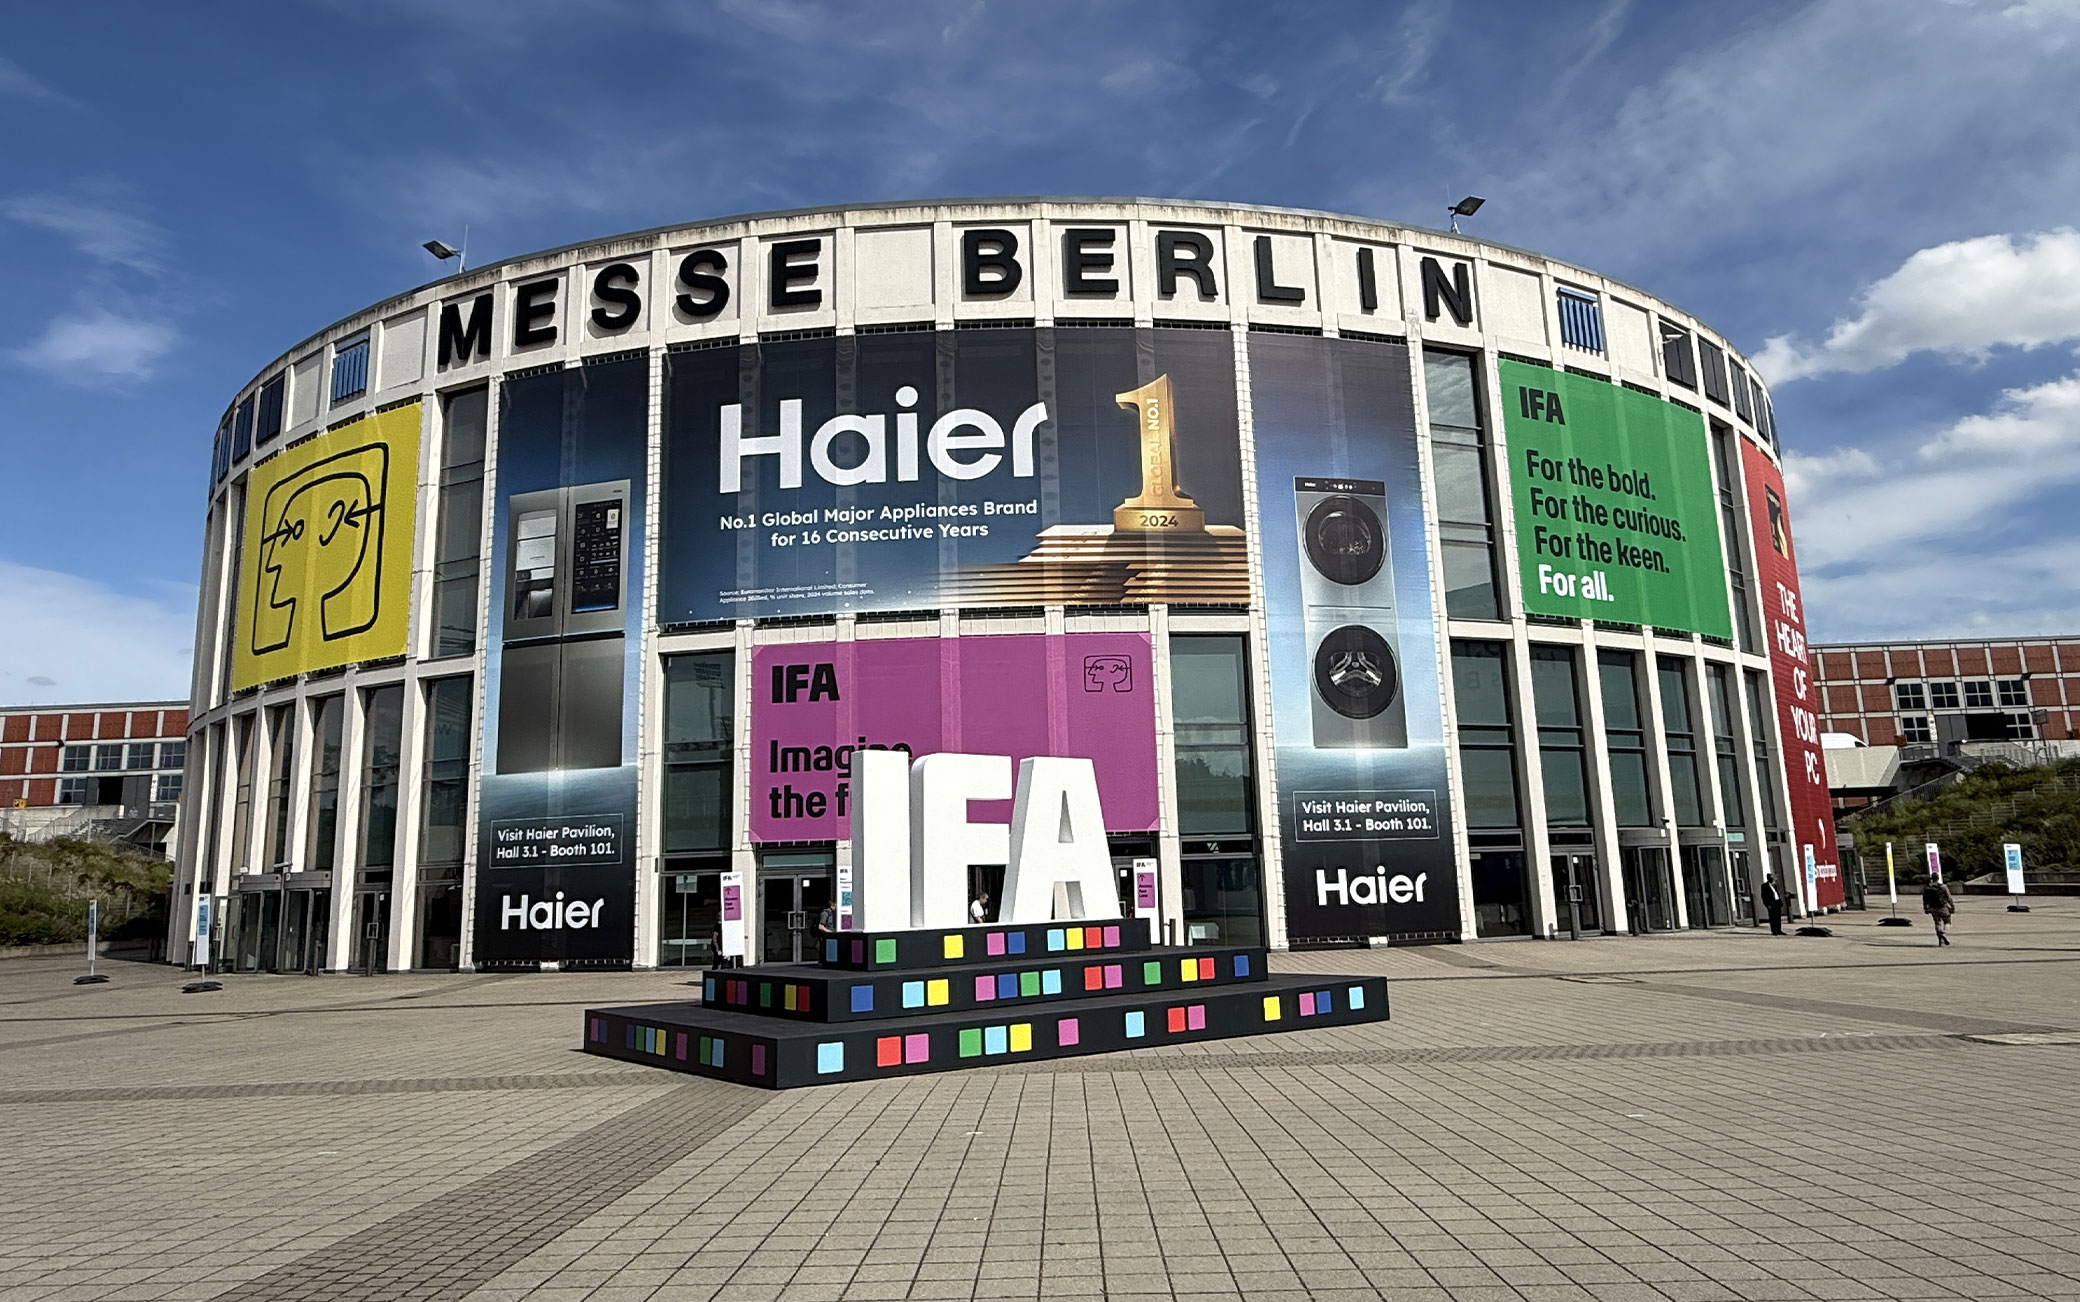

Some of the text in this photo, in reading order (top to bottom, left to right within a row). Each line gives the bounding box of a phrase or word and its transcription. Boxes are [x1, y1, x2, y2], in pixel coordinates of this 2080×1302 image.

[438, 228, 1474, 366] MESSE BERLIN
[1146, 398, 1161, 431] NO.1
[1519, 386, 1566, 425] IFA
[719, 386, 1048, 494] Haier
[1526, 449, 1656, 501] For the bold.
[720, 499, 1038, 531] No.1 Global Major Appliances Brand
[1140, 515, 1179, 527] 2024
[1530, 487, 1686, 542] For the curious.
[770, 522, 989, 548] for 16 Consecutive Years
[1534, 526, 1670, 574] For the keen.
[1538, 563, 1615, 602] For all.
[1777, 582, 1799, 624] THE
[771, 663, 840, 704] IFA
[1793, 667, 1807, 700] OF
[770, 736, 912, 778] Imag
[1804, 750, 1820, 785] PC
[769, 784, 827, 818] the
[1302, 800, 1430, 814] Visit Haier Pavilion,
[498, 824, 615, 842] Visit Haier Pavilion,
[852, 750, 1123, 932] IFA
[1303, 819, 1330, 832] Hall
[1334, 818, 1352, 831] 3.1
[1365, 818, 1403, 831] Booth
[1407, 817, 1432, 830] 101.
[496, 847, 519, 859] Hall
[522, 846, 539, 858] 3.1
[550, 843, 587, 857] Booth
[590, 842, 615, 856] 101.
[1316, 865, 1427, 906] Haier
[501, 891, 605, 930] Haier
